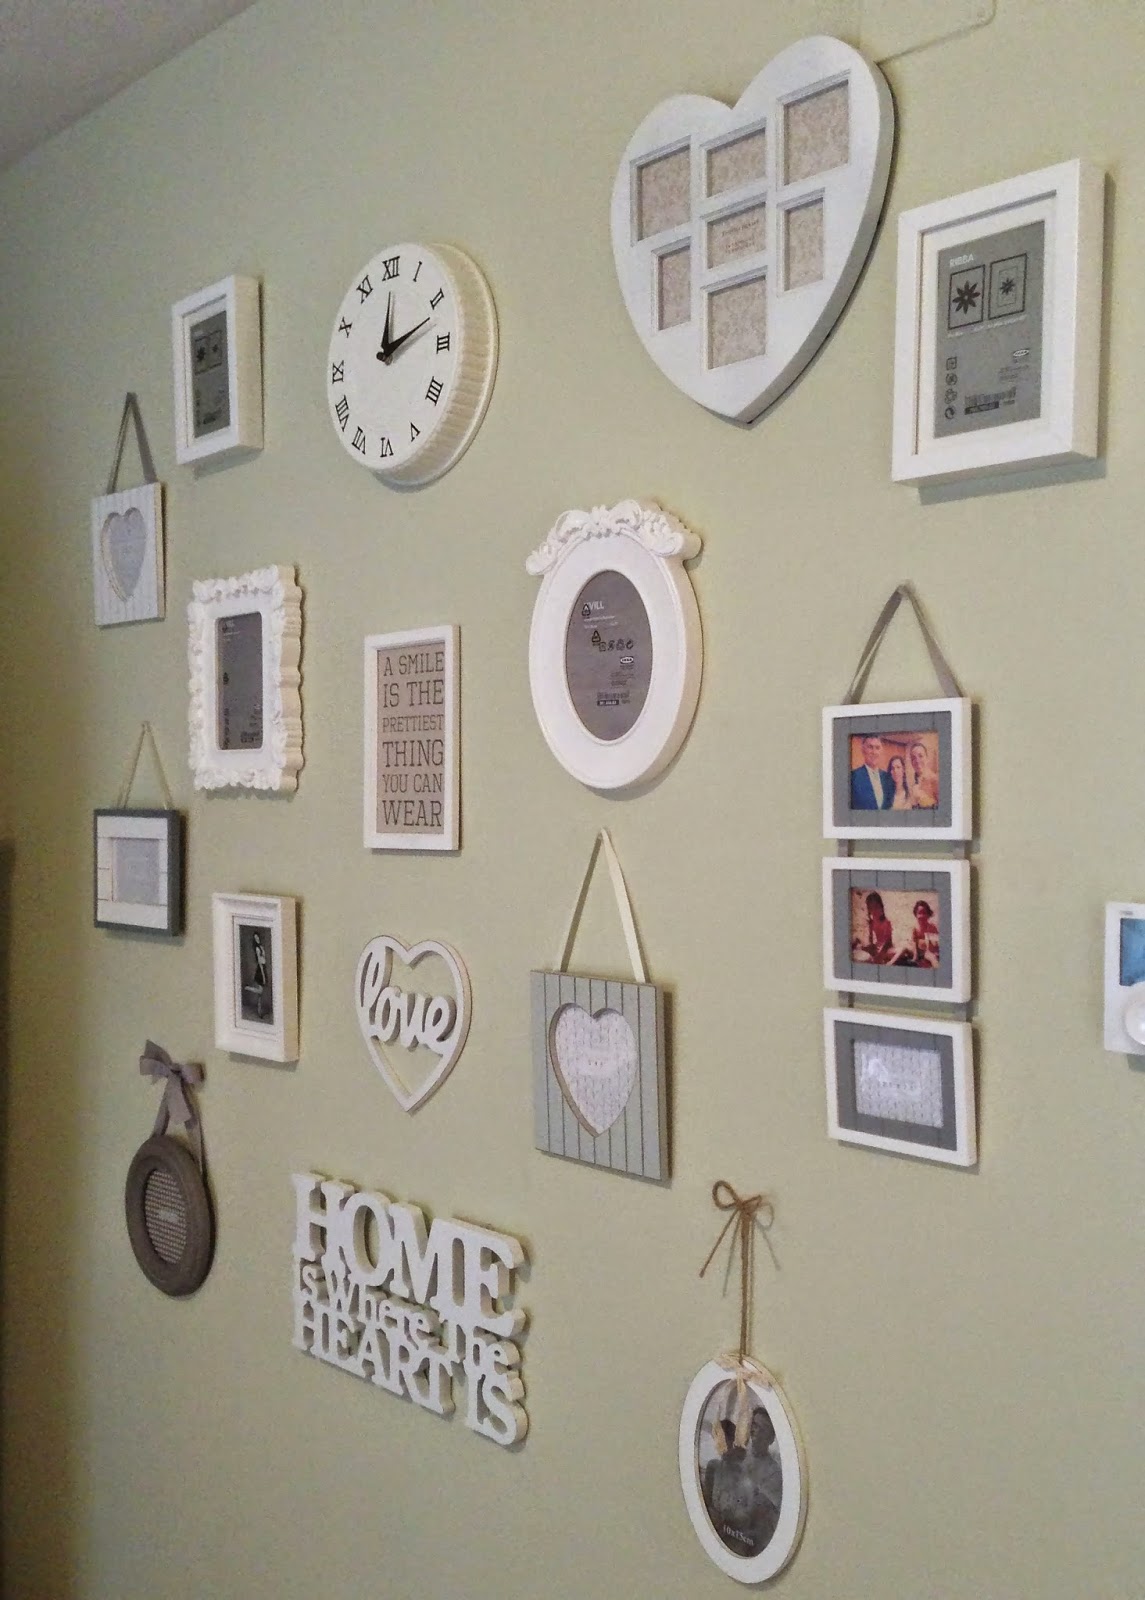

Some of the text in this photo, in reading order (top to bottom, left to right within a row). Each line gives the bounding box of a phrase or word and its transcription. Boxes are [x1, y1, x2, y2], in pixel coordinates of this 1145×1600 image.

[382, 256, 400, 281] XII
[413, 261, 423, 282] I
[356, 275, 373, 304] XI
[430, 288, 444, 310] II
[339, 317, 352, 338] X
[436, 332, 450, 354] III
[332, 360, 344, 384] IX
[425, 376, 443, 406] IIII
[335, 395, 349, 432] VIII
[352, 426, 366, 454] VII
[410, 422, 421, 442] V
[380, 437, 394, 457] VI
[383, 651, 444, 676] A SMILE
[383, 680, 444, 708] IS THE
[382, 714, 444, 733] PRETTIEST
[382, 739, 444, 767] THING
[382, 773, 443, 793] YOU CAN
[382, 800, 442, 827] WEAR
[292, 1173, 525, 1338] HOME
[293, 1297, 528, 1445] HEART IS
